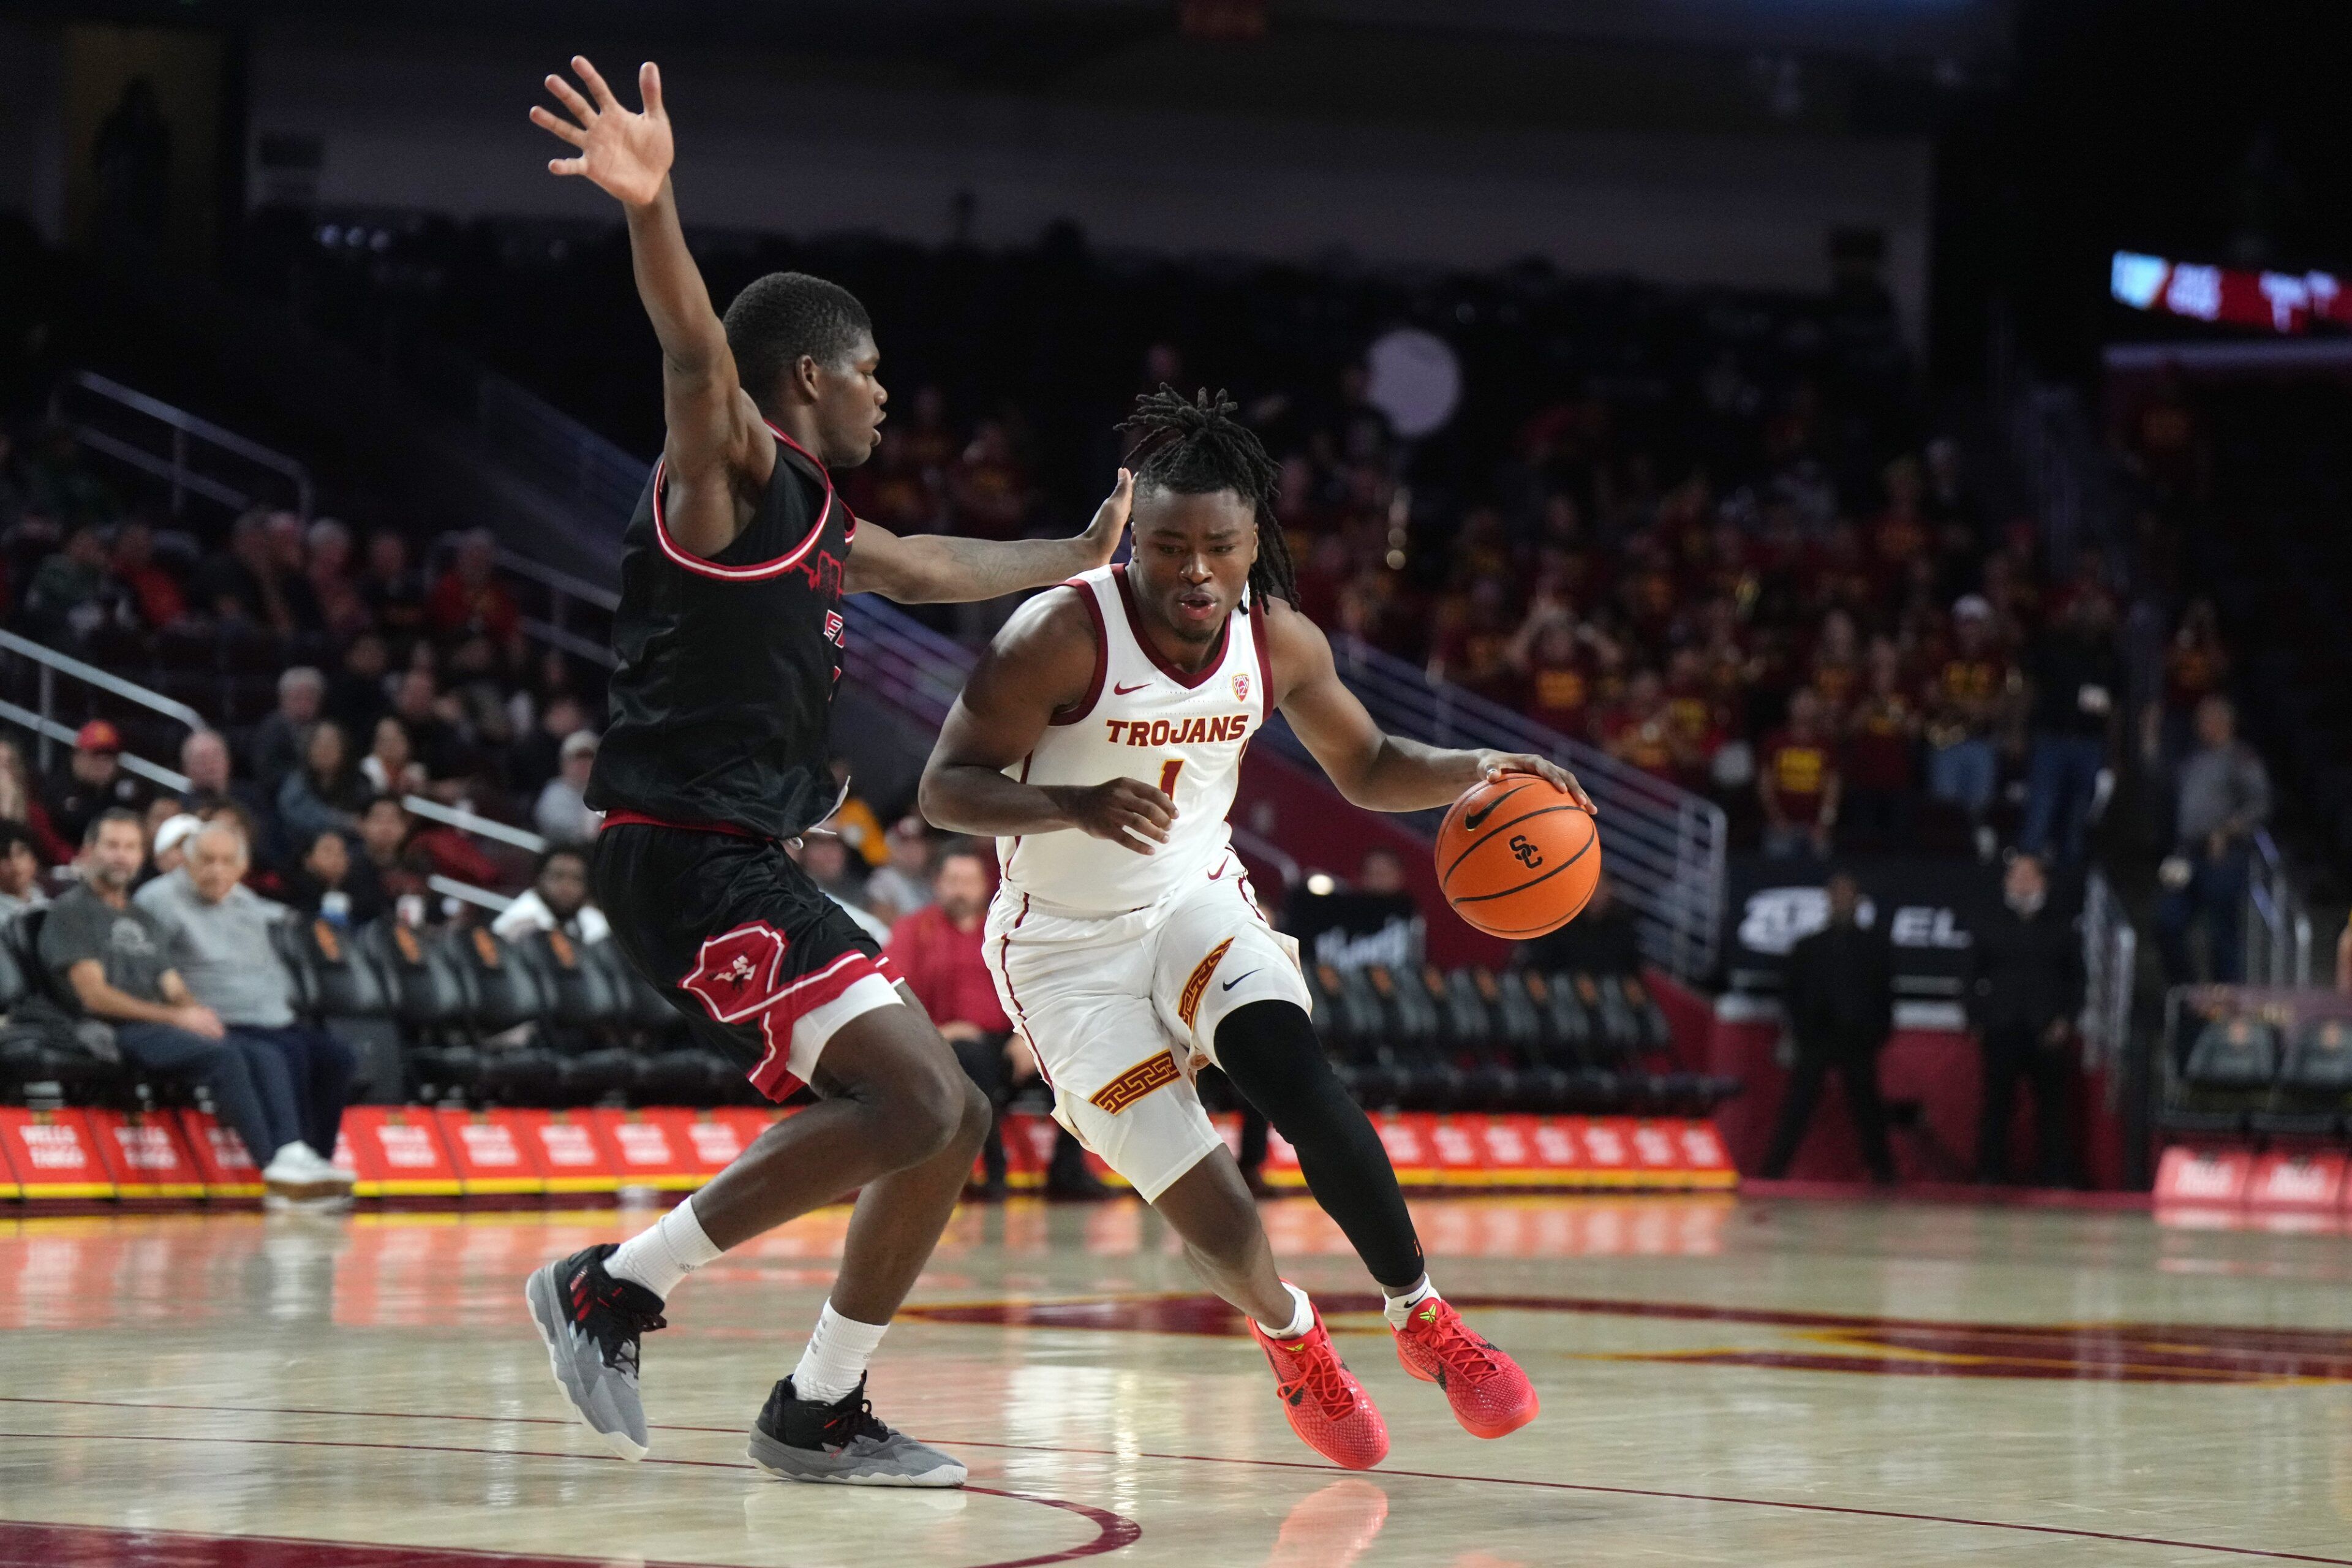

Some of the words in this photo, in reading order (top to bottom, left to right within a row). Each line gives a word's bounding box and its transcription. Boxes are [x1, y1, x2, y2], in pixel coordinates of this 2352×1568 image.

[1237, 685, 1246, 696] 12
[1106, 714, 1250, 747] TROJANS
[1159, 759, 1185, 801] 1
[1509, 834, 1543, 869] SC
